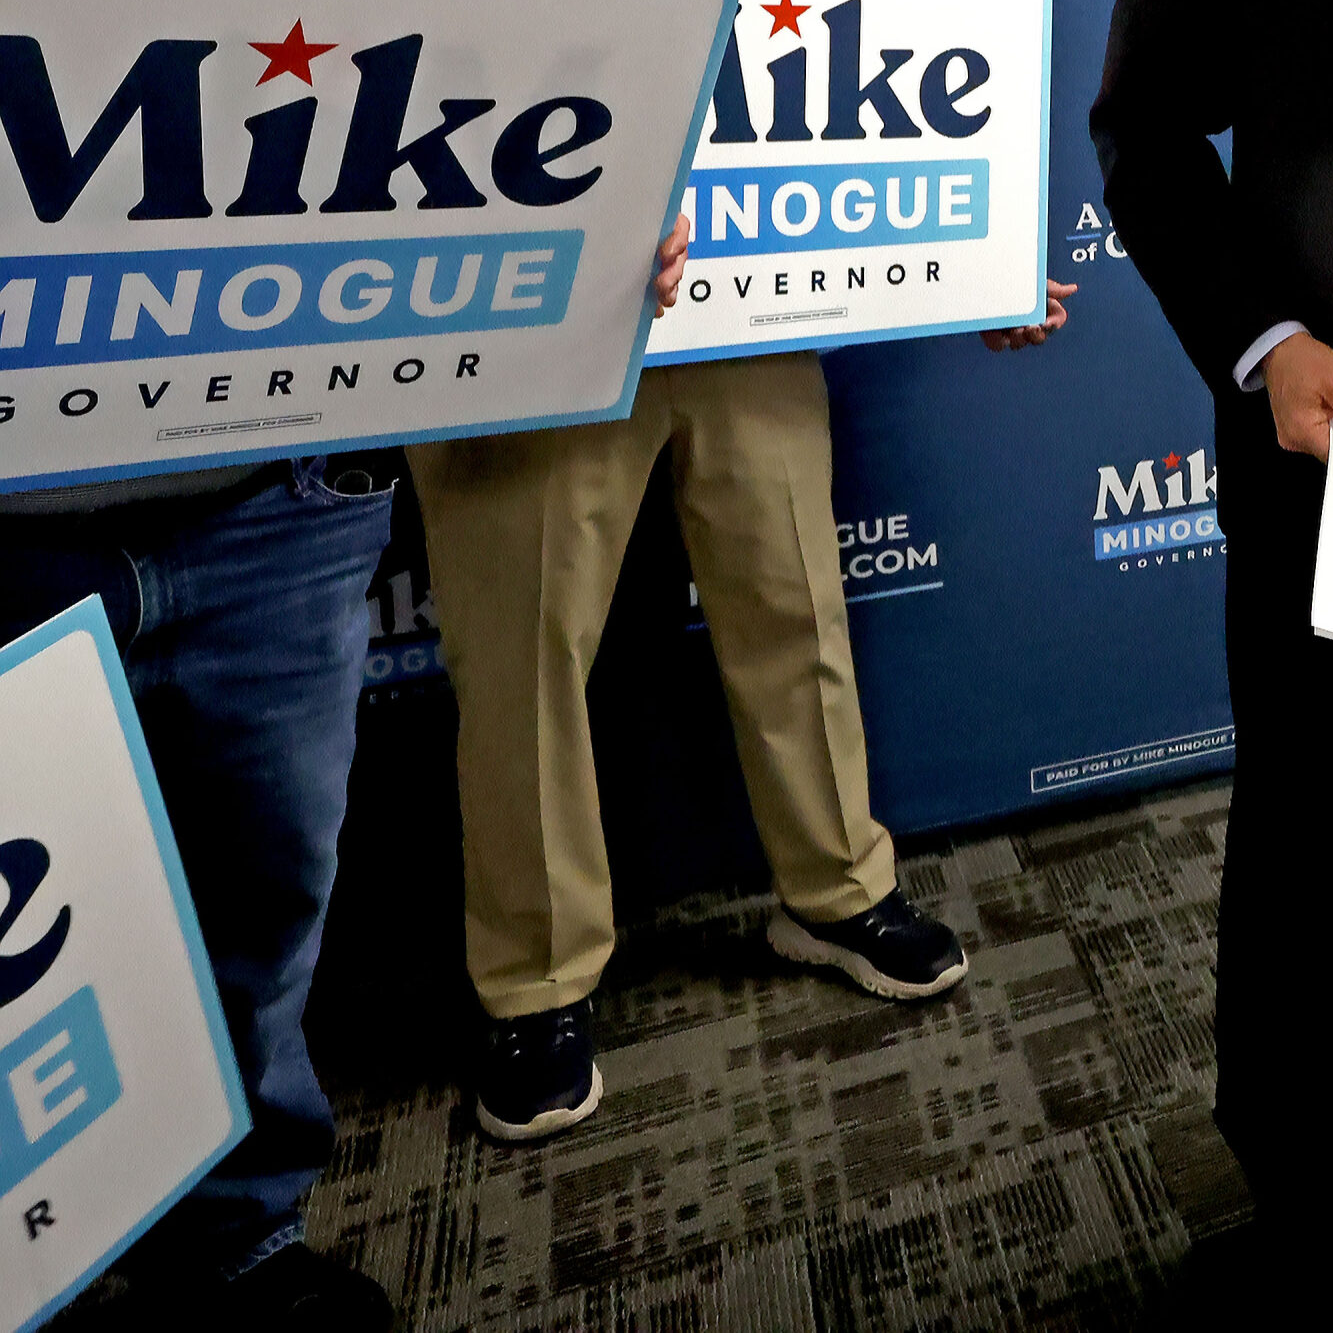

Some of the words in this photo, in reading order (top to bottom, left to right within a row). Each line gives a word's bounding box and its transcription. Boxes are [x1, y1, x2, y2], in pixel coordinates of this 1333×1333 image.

[680, 174, 973, 243] INOGUE
[1076, 203, 1101, 231] A
[1072, 241, 1098, 262] of
[690, 261, 941, 303] OVERNOR
[1093, 449, 1217, 520] Mik
[1103, 515, 1215, 553] MINOG
[1046, 768, 1078, 782] PAID
[1082, 762, 1109, 774] FOR
[1113, 757, 1128, 768] BY
[1132, 749, 1165, 764] MIKE
[1168, 735, 1227, 753] MINOGUE
